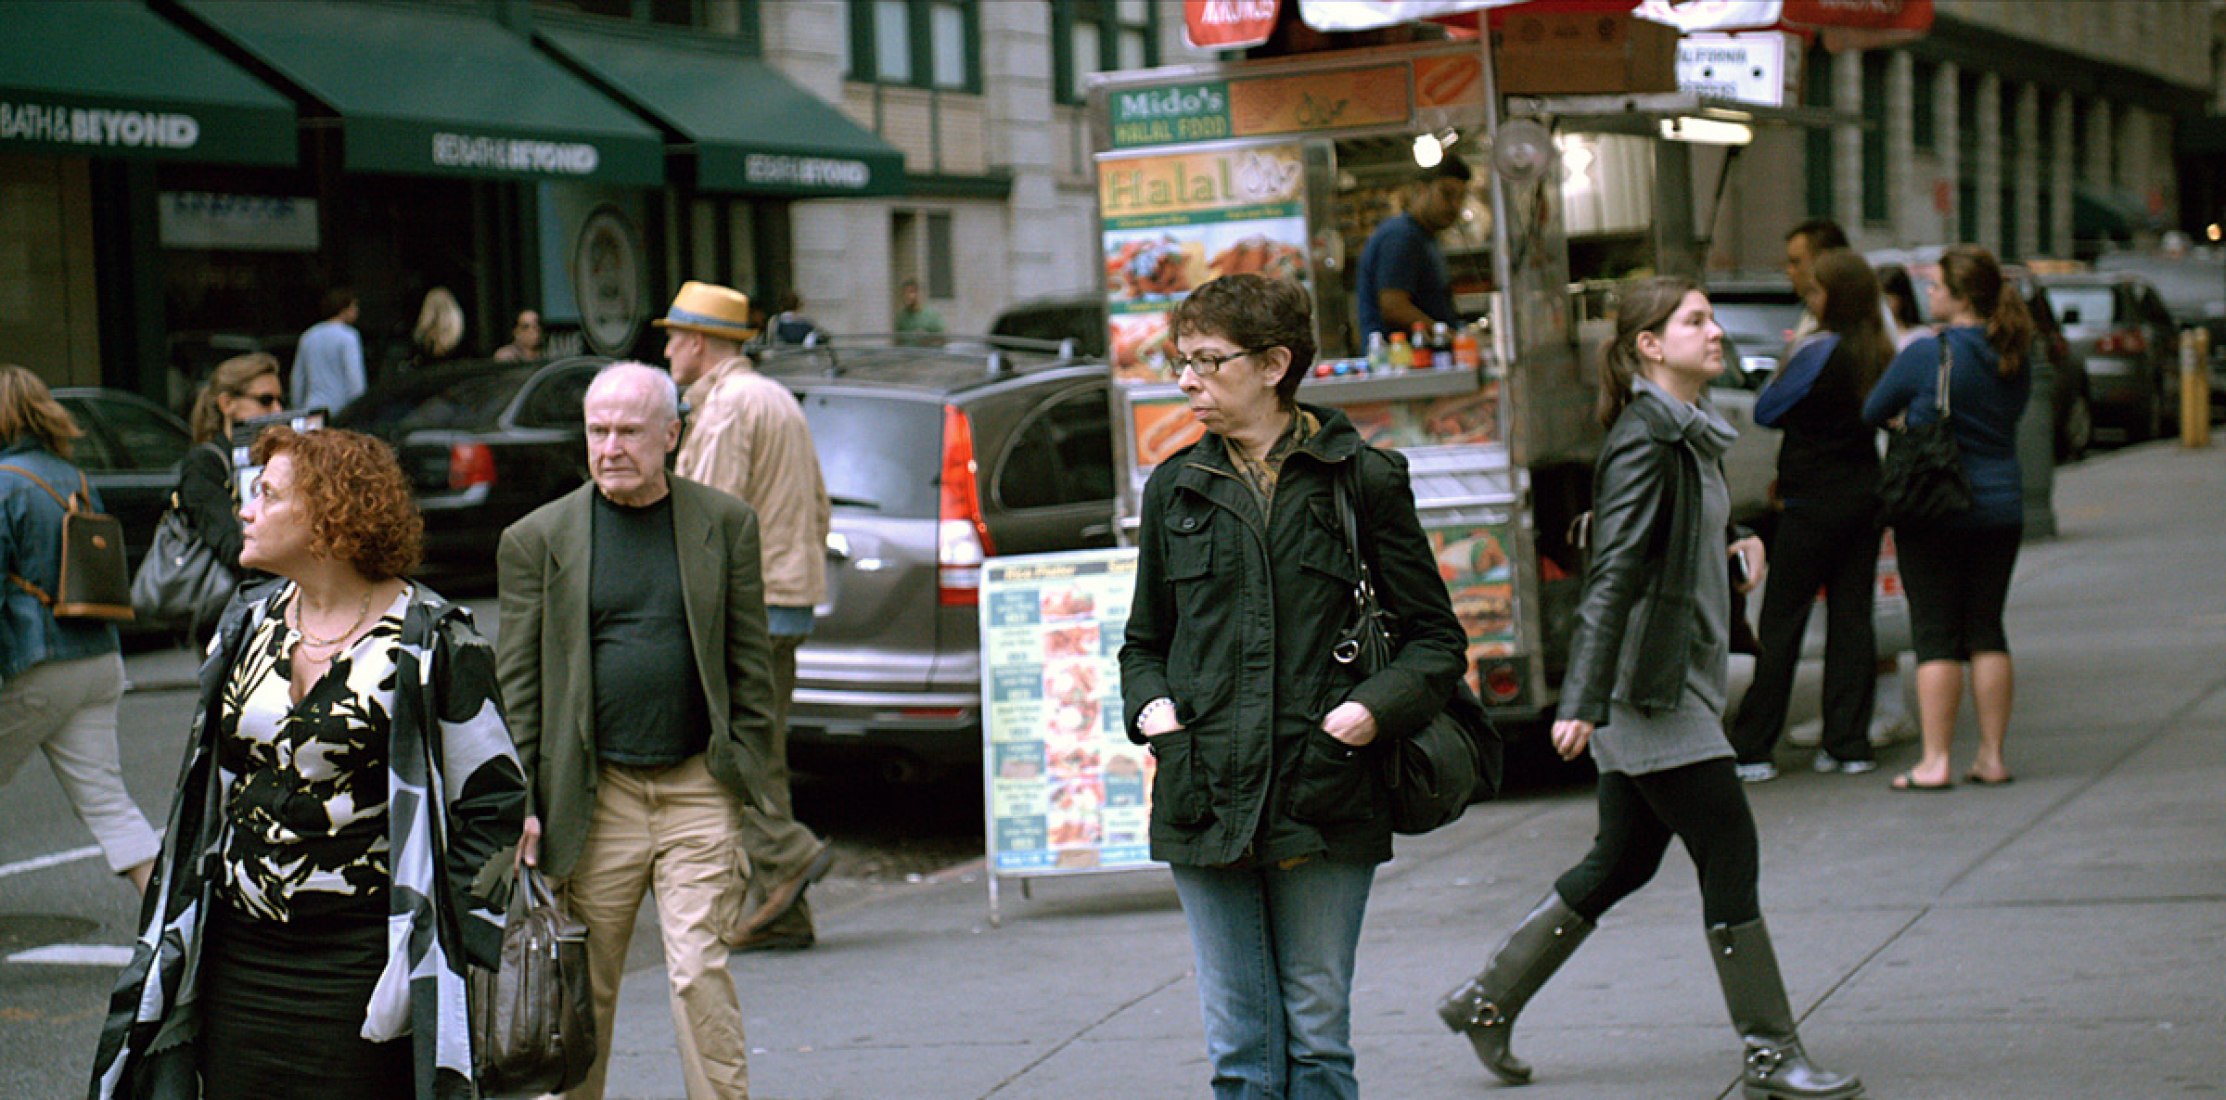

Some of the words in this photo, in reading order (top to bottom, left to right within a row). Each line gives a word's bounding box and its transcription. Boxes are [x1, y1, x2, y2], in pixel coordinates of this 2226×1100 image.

[1676, 47, 1747, 63] ALIFORNIA
[1121, 86, 1224, 119] Mido's
[0, 102, 53, 140] BATH
[71, 107, 200, 149] BEYOND
[1114, 120, 1173, 145] HALAL
[1178, 114, 1226, 139] FOOD
[508, 139, 600, 175] BEYOND
[1106, 157, 1235, 209] Halal
